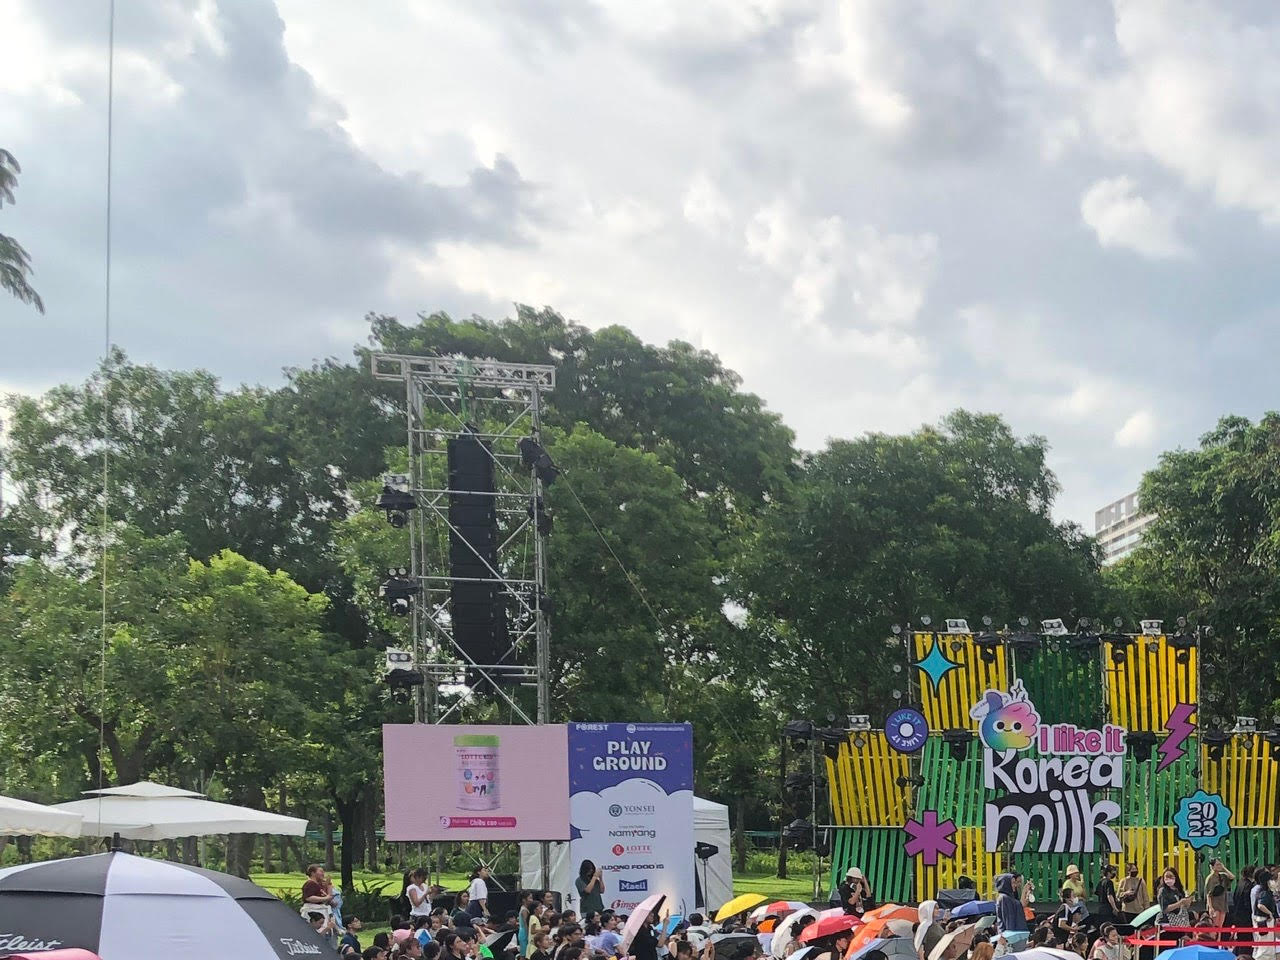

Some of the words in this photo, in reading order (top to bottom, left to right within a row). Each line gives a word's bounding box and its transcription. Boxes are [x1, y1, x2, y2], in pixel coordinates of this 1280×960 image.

[894, 713, 912, 723] LIKE
[607, 740, 651, 755] PLAY
[1039, 726, 1048, 753] I
[1053, 725, 1102, 753] like
[1105, 725, 1125, 753] it
[593, 756, 667, 771] GROUND
[984, 747, 1123, 794] Korea
[1187, 801, 1216, 820] 20
[984, 788, 1124, 854] milk
[1187, 819, 1216, 837] 23
[620, 882, 647, 890] Maeil
